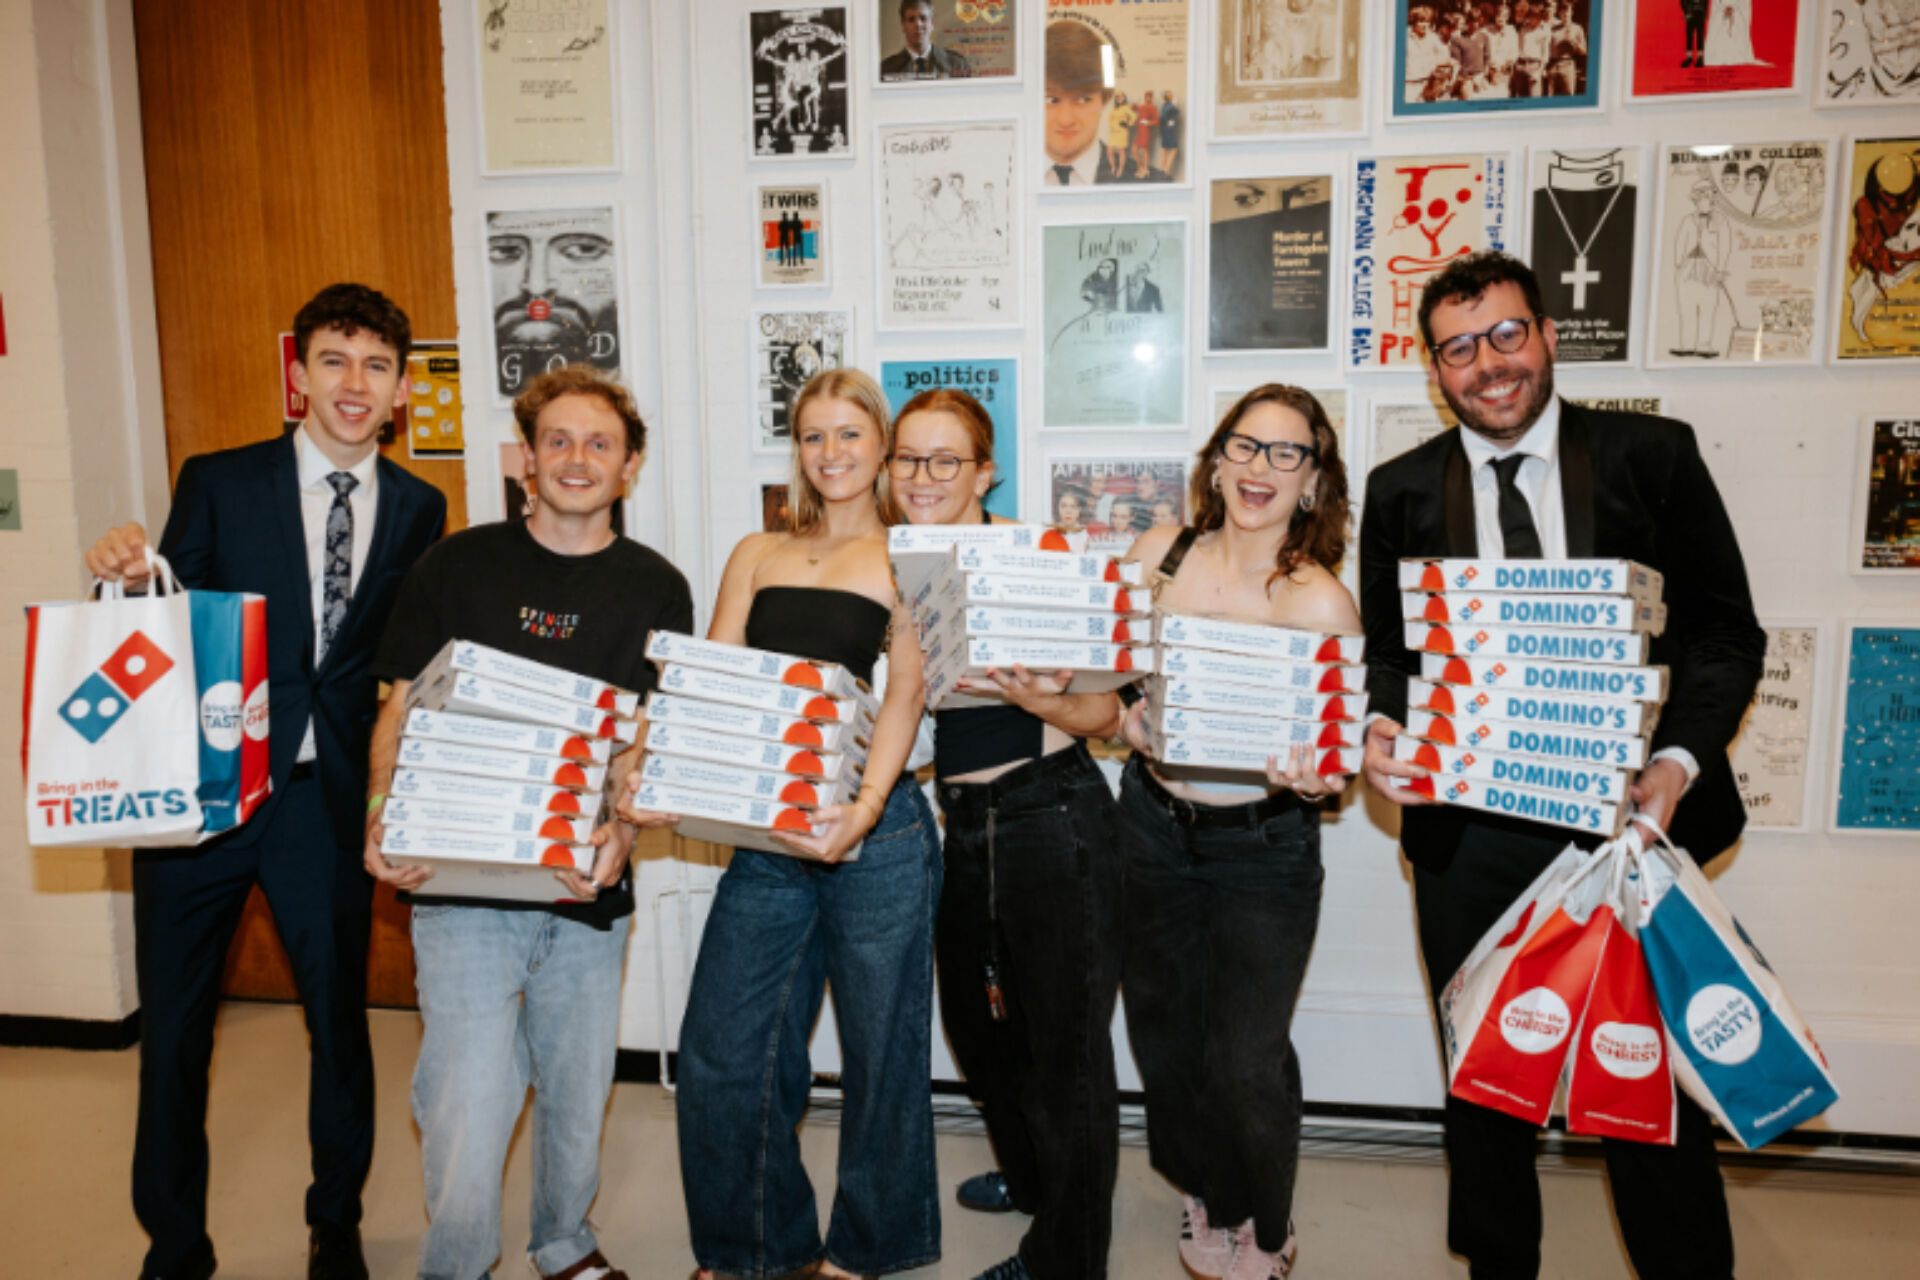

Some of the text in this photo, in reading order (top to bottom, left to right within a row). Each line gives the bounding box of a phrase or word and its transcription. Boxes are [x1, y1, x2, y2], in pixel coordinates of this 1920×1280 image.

[768, 193, 819, 209] TWINS
[1273, 230, 1310, 242] Murder
[1274, 257, 1310, 267] Towers
[905, 365, 1000, 389] politics
[1496, 567, 1613, 590] DOMINO'S
[1500, 601, 1618, 625] DOMINO'S
[521, 620, 576, 639] PROJECT
[1507, 633, 1626, 660] DOMINO'S
[1525, 667, 1645, 696] DOMINO'S
[1507, 698, 1626, 728] DOMINO'S
[1508, 731, 1628, 764] DOMINO'S
[37, 778, 119, 796] Bring in the
[1493, 759, 1610, 796] DOMINO'S
[37, 789, 188, 828] TREATS
[1486, 788, 1602, 829] DOMINO'S
[1504, 1016, 1564, 1037] CHEESY
[1701, 1005, 1752, 1052] TASTY
